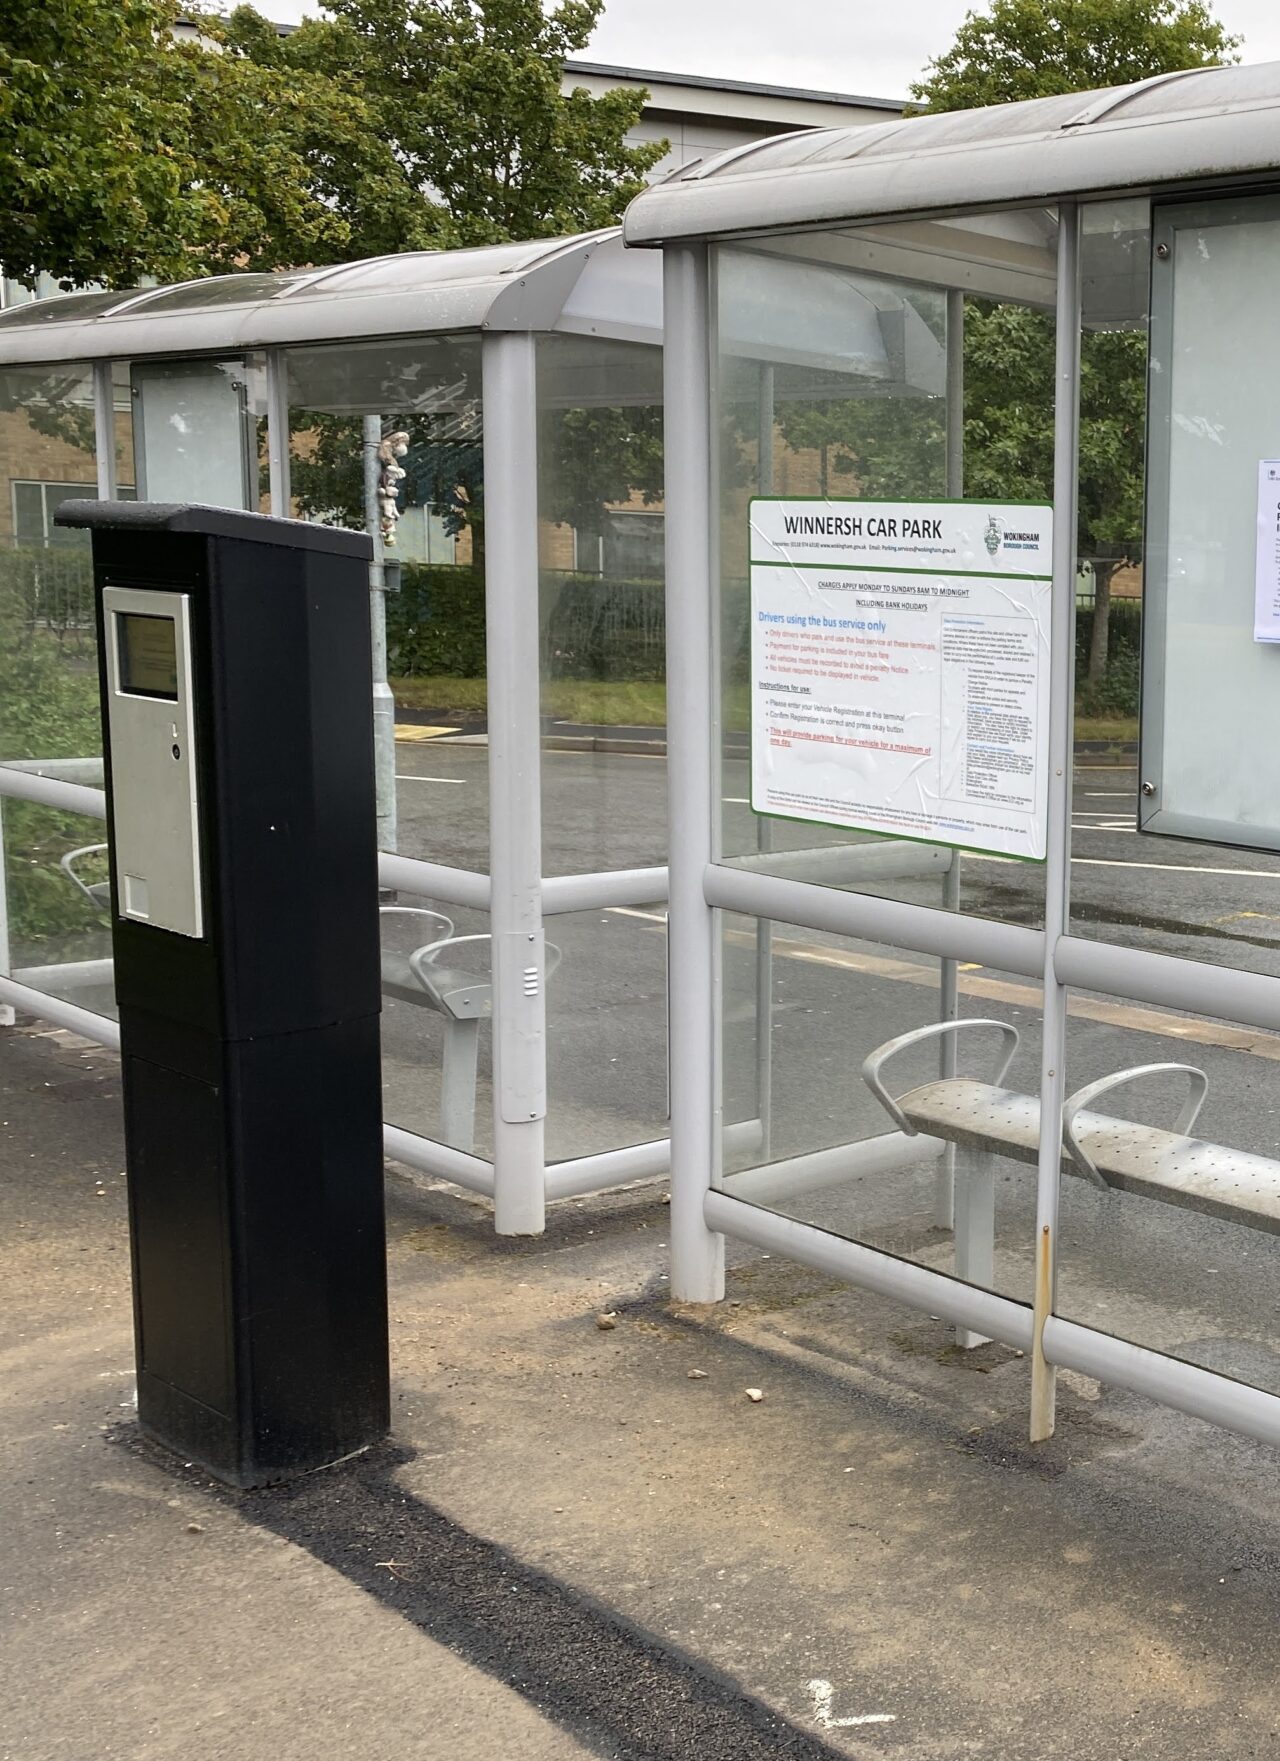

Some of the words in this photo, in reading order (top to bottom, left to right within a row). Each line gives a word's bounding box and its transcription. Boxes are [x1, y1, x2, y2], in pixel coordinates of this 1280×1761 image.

[784, 516, 862, 536] WINNERSH
[867, 518, 897, 538] CAR
[902, 519, 942, 539] PARK
[1003, 532, 1040, 542] WOKINGHAM
[818, 581, 841, 589] CHARGES
[892, 586, 916, 594] SUNDAYS
[940, 588, 969, 596] MIDNIGHT
[856, 600, 884, 608] INCLUDING
[902, 602, 928, 610] HOLIDAYS
[759, 612, 784, 623] Drivers
[787, 615, 806, 627] using
[809, 616, 820, 626] the
[823, 616, 836, 627] bus
[839, 619, 865, 629] service
[868, 620, 886, 632] only
[759, 681, 789, 690] Instructions
